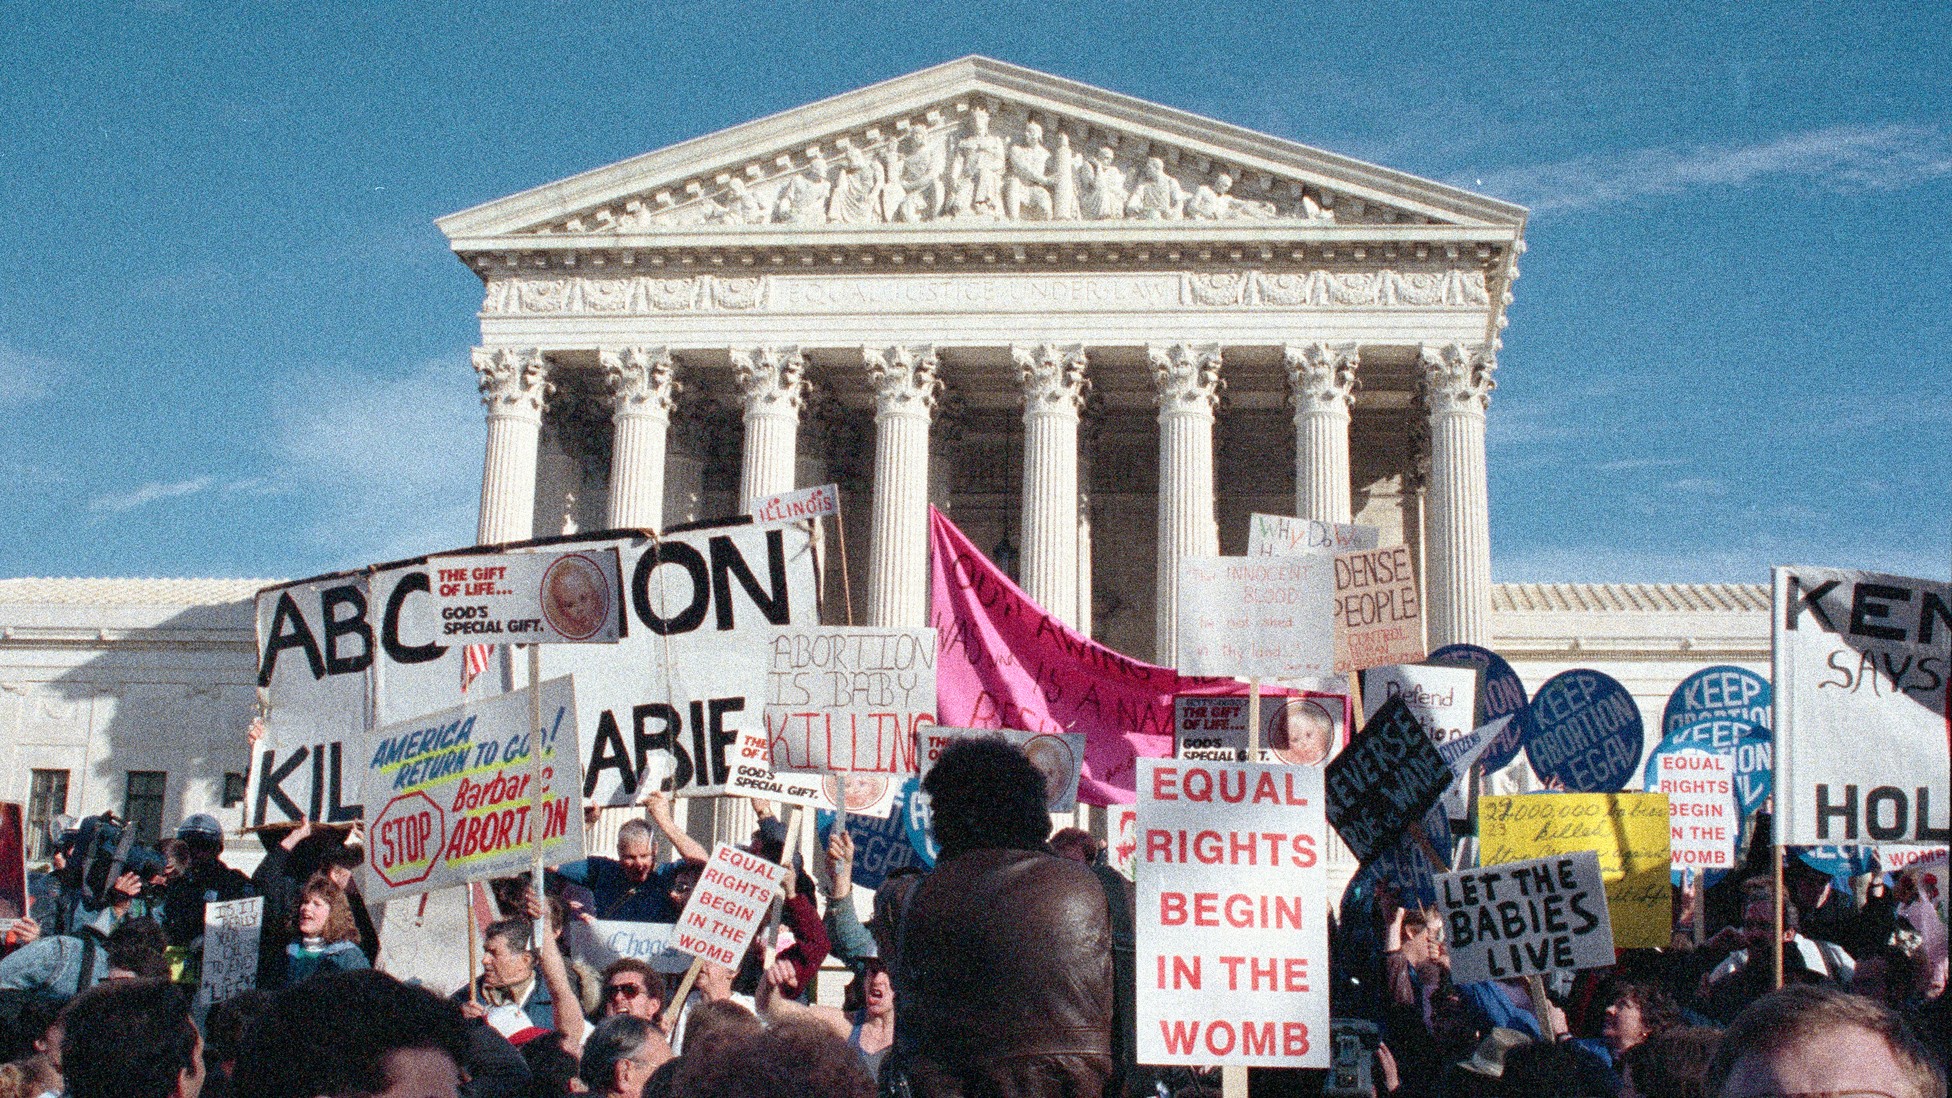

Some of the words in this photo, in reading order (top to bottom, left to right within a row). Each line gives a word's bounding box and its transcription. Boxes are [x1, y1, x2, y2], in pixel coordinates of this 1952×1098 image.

[1009, 281, 1102, 300] UNDER
[1113, 280, 1165, 299] LAW
[759, 492, 833, 523] ILLINOIS
[438, 569, 468, 583] THE
[472, 567, 507, 581] GIFT
[1227, 565, 1313, 582] INNOCENT
[1334, 549, 1410, 590] DENSE
[439, 584, 461, 597] OF
[465, 582, 513, 597] LIFE...
[1243, 586, 1298, 605] BLOOD
[441, 605, 489, 620] GOD'S
[1334, 587, 1417, 628] PEOPLE
[443, 620, 504, 635] SPECIAL
[508, 618, 544, 633] GIFT.
[769, 633, 935, 670] ABORTION
[767, 672, 809, 707] IS
[823, 673, 917, 709] BABY
[1818, 649, 1944, 698] SAYS
[1387, 681, 1454, 706] Defend
[1534, 675, 1597, 730] KEEP
[1684, 672, 1762, 711] KEEP
[1183, 707, 1207, 718] THE
[1211, 706, 1241, 718] GIFT
[1183, 719, 1201, 730] OF
[370, 714, 477, 769] AMERICA
[583, 697, 745, 798] ABIE
[929, 736, 949, 747] TH
[1531, 691, 1636, 773] ABORTION
[392, 747, 472, 790] RETURN
[474, 740, 499, 768] TO
[741, 748, 759, 759] OF
[1183, 750, 1233, 761] SPECIAL
[1663, 757, 1725, 771] EQUAL
[254, 742, 364, 825] KIL
[452, 766, 554, 812] Barbarc
[734, 776, 783, 794] SPECIAL
[788, 786, 819, 800] GIFT.
[1153, 767, 1308, 806] EQUAL
[1661, 780, 1729, 794] RIGHTS
[381, 811, 431, 869] STOP
[445, 796, 570, 861] ABORTON
[1688, 826, 1725, 840] THE
[718, 847, 777, 881] EQUAL
[1146, 829, 1317, 868] RIGHTS
[1669, 849, 1725, 864] WOMB
[705, 868, 770, 903] RIGHTS
[1444, 871, 1500, 909] LET
[1512, 860, 1577, 896] THE
[699, 892, 754, 922] BEGIN
[1160, 892, 1302, 929] BEGIN
[1449, 891, 1599, 948] BABIES
[687, 912, 709, 929] IN
[712, 921, 747, 944] THE
[679, 933, 735, 965] WOMB
[1488, 936, 1575, 976] LIVE
[1157, 955, 1201, 990] IN
[1219, 956, 1310, 992] THE
[1160, 1020, 1310, 1057] WOMB
